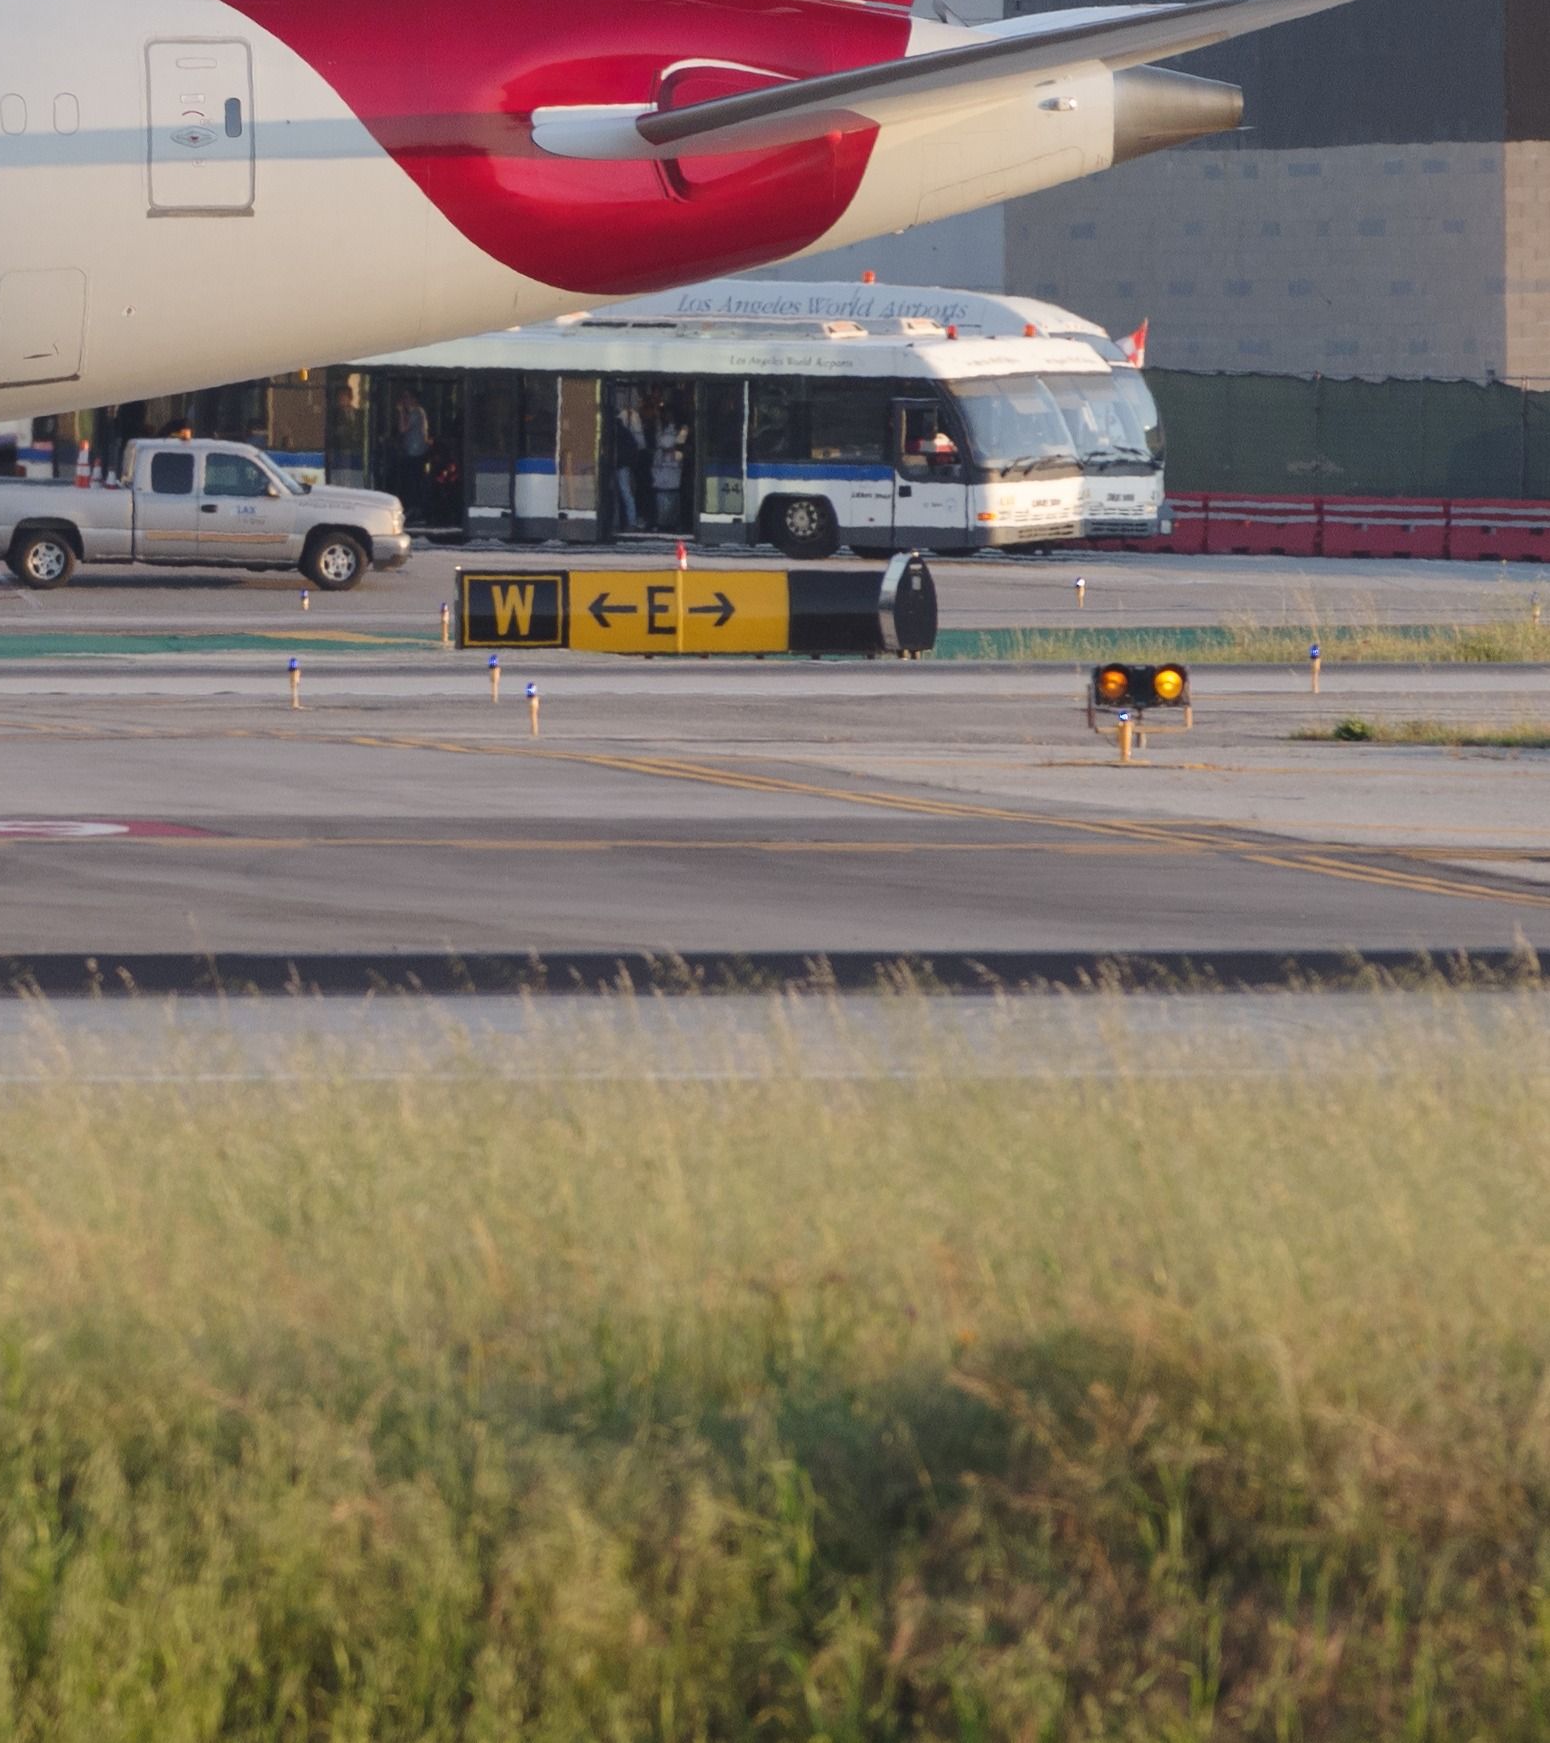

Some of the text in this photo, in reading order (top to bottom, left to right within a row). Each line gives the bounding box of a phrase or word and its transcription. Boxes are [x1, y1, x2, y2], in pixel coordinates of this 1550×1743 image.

[678, 294, 969, 323] Los Angeles World Airports
[491, 584, 677, 636] W E
